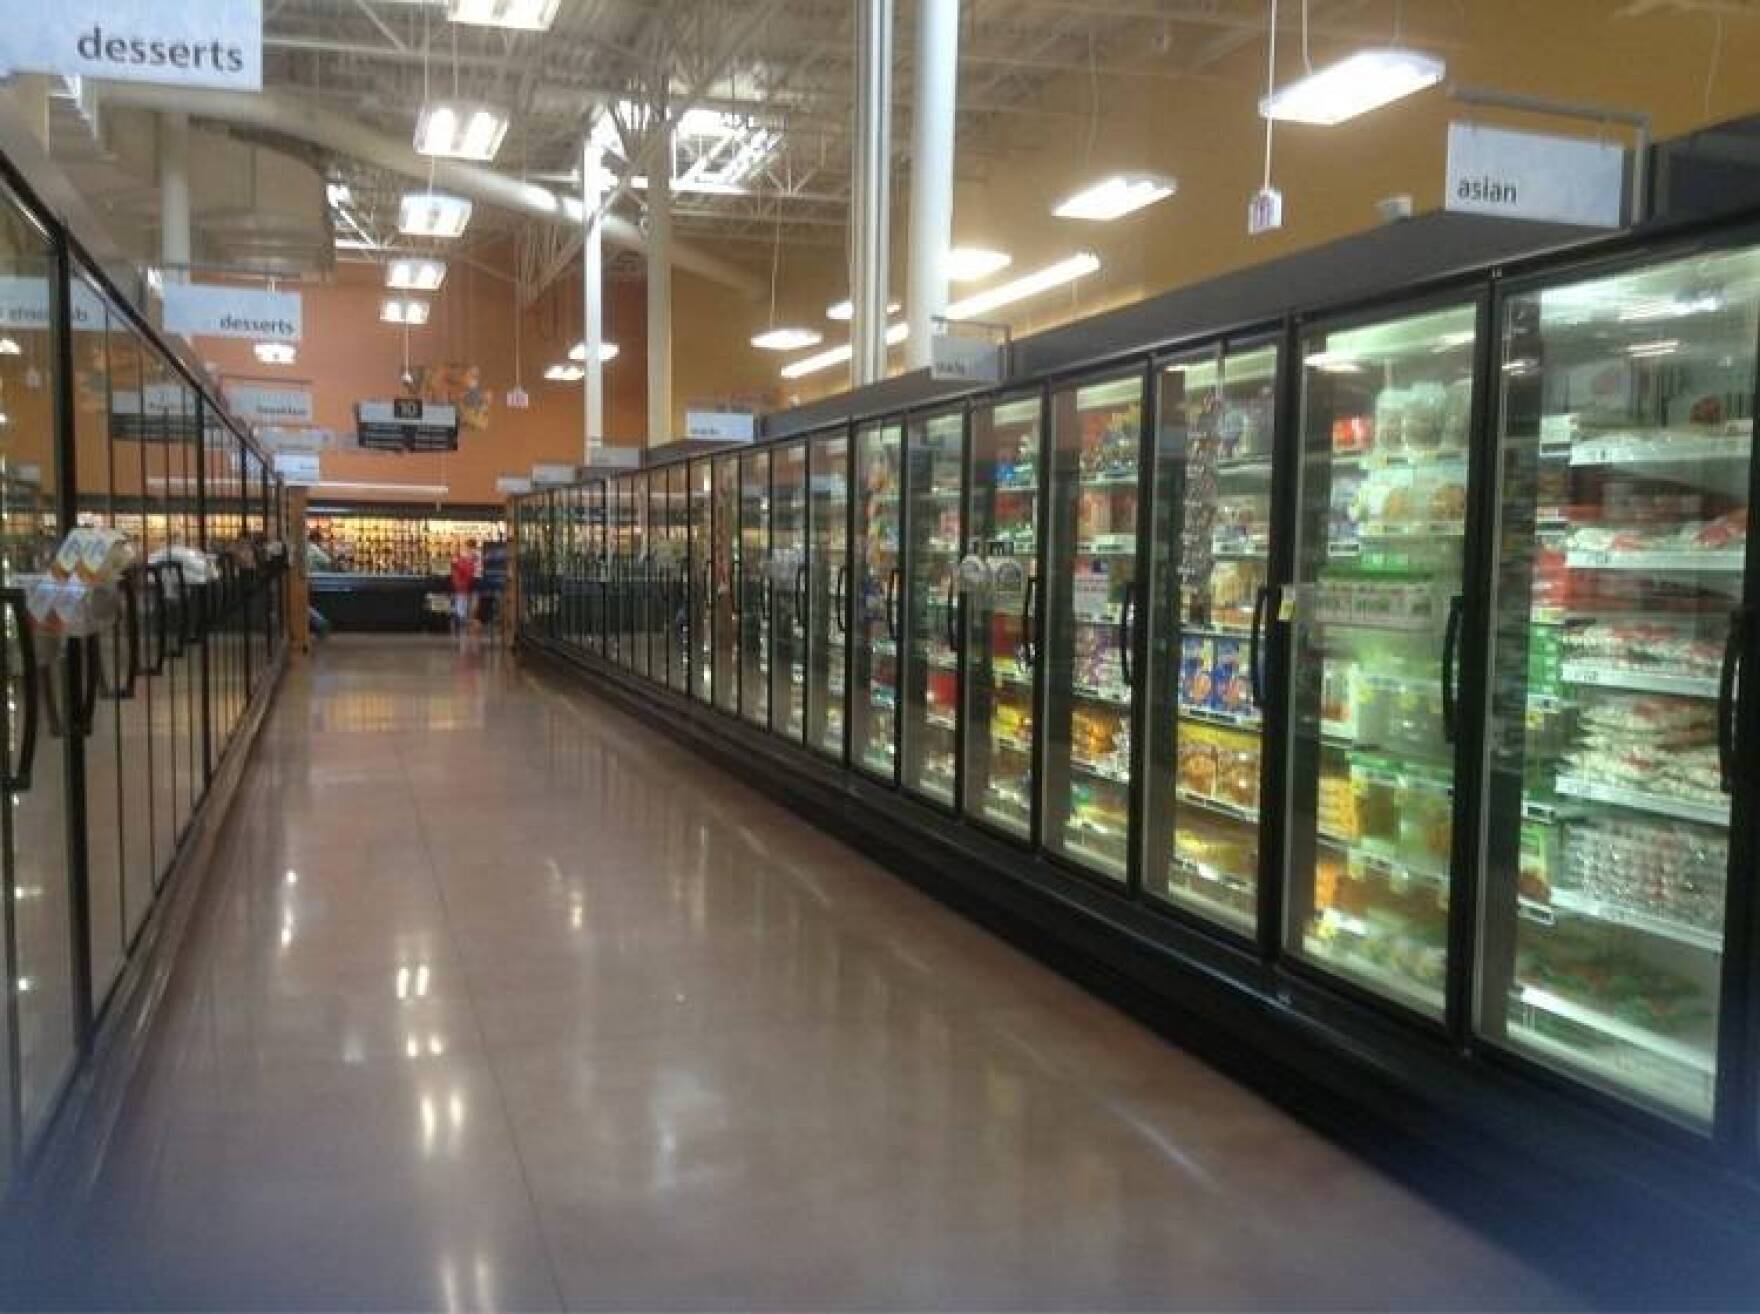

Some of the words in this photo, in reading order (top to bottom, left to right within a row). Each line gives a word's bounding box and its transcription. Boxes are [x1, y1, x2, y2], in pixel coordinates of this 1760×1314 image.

[77, 26, 243, 72] desserts
[1457, 174, 1517, 205] asian
[219, 312, 295, 336] desserts
